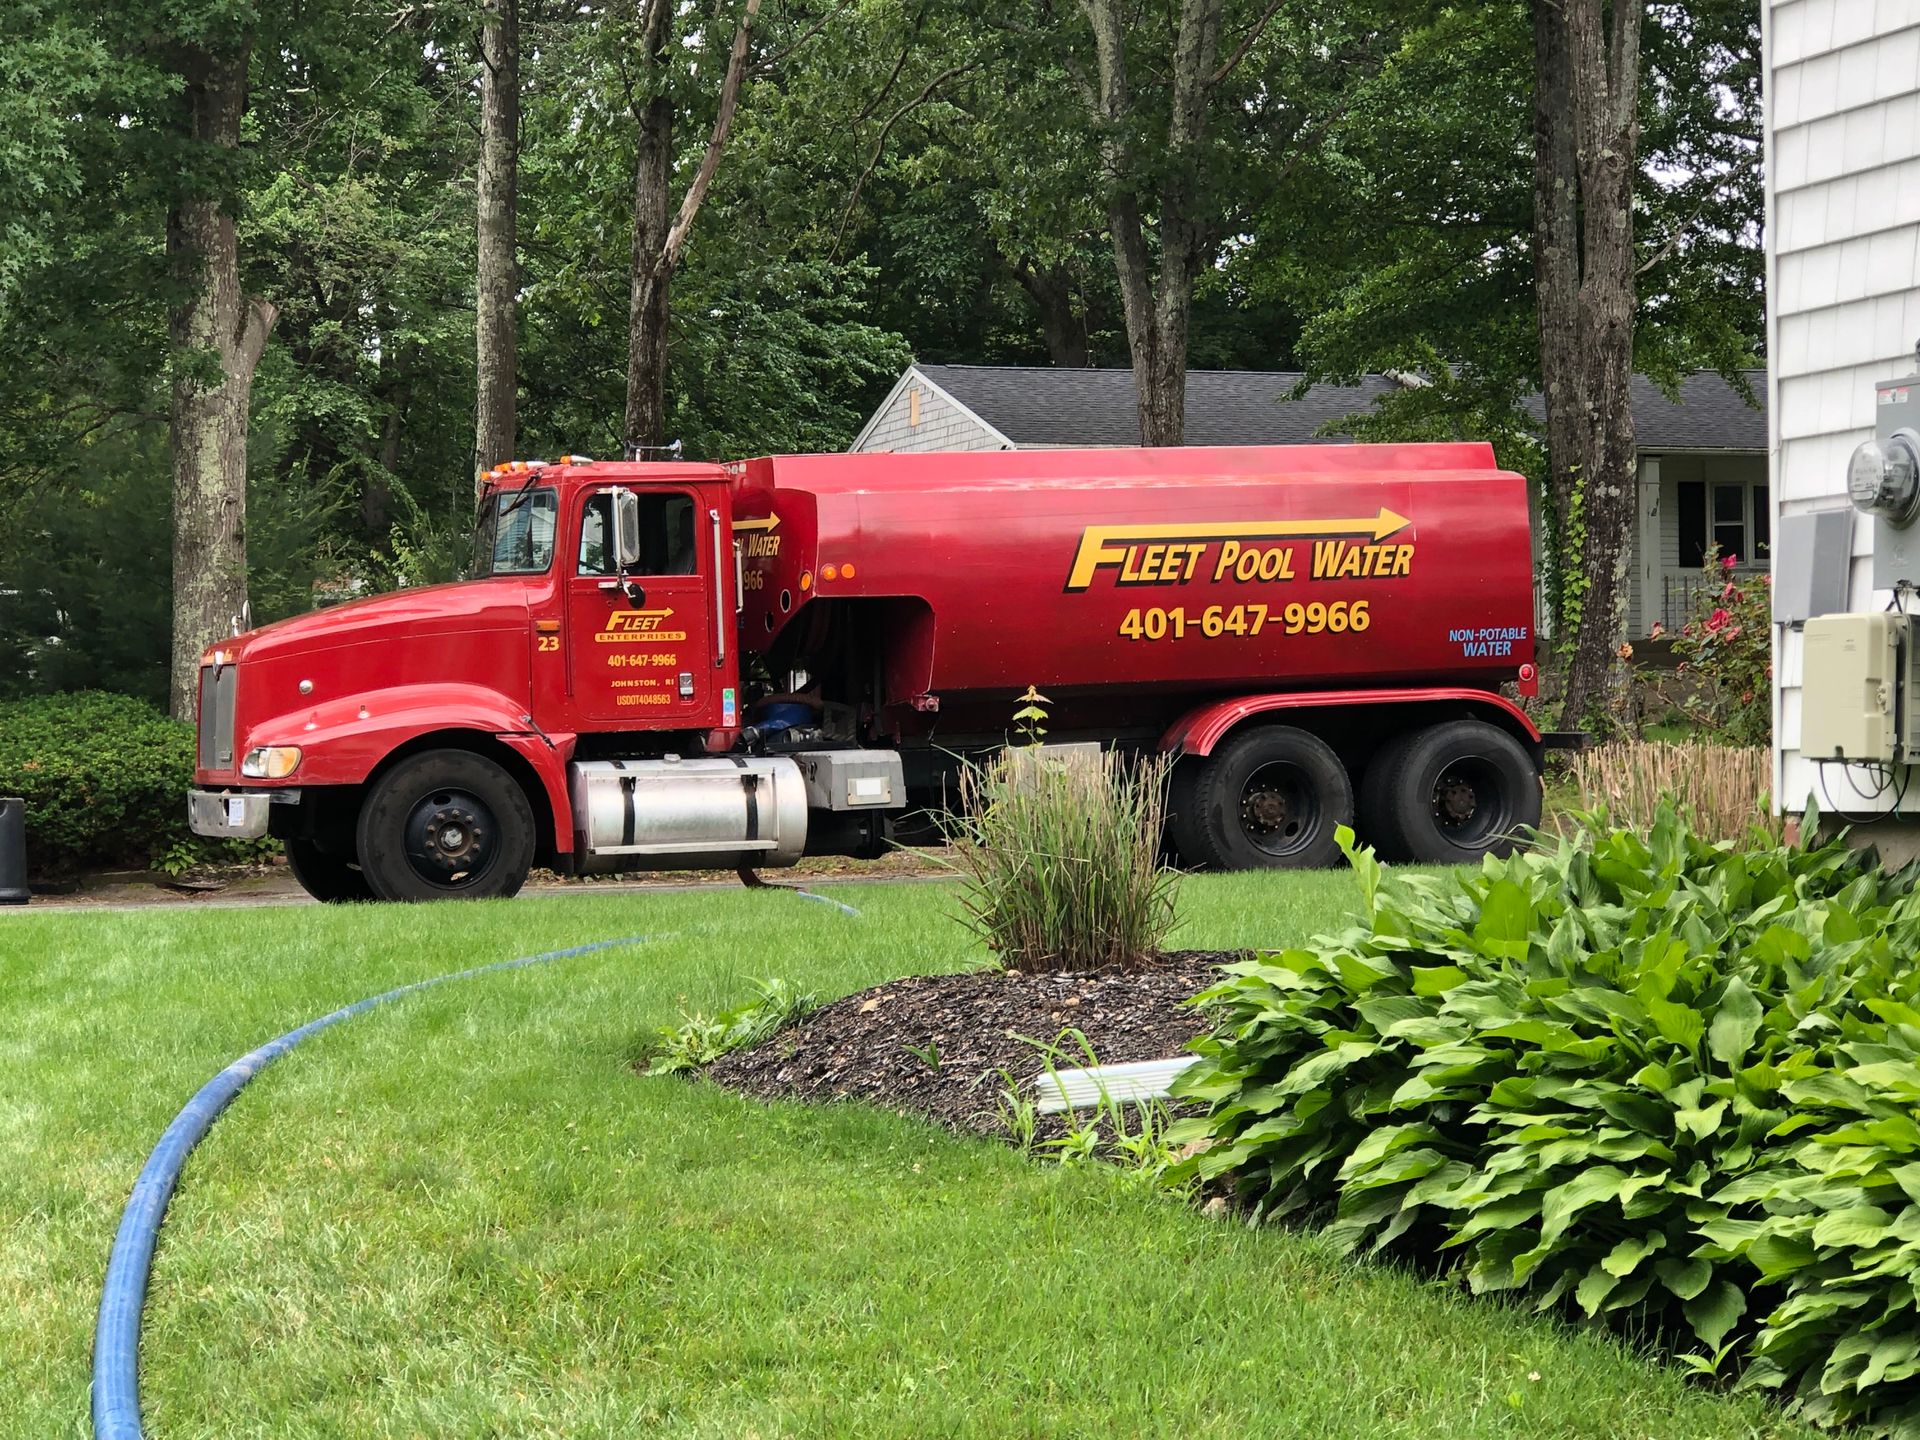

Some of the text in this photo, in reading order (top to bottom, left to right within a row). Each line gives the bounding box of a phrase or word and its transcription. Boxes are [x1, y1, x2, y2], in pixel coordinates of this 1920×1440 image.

[748, 533, 780, 557] WATER
[1064, 526, 1415, 591] FLEET POOL WATER
[605, 610, 663, 631] FLEET
[1118, 600, 1371, 640] 401-647-9966
[599, 633, 682, 641] ENTERPRISES
[1449, 627, 1527, 642] NON-POTABLE
[538, 636, 560, 652] 23
[1463, 641, 1512, 657] WATER
[607, 654, 677, 667] 401-647-9966
[665, 678, 675, 686] RI
